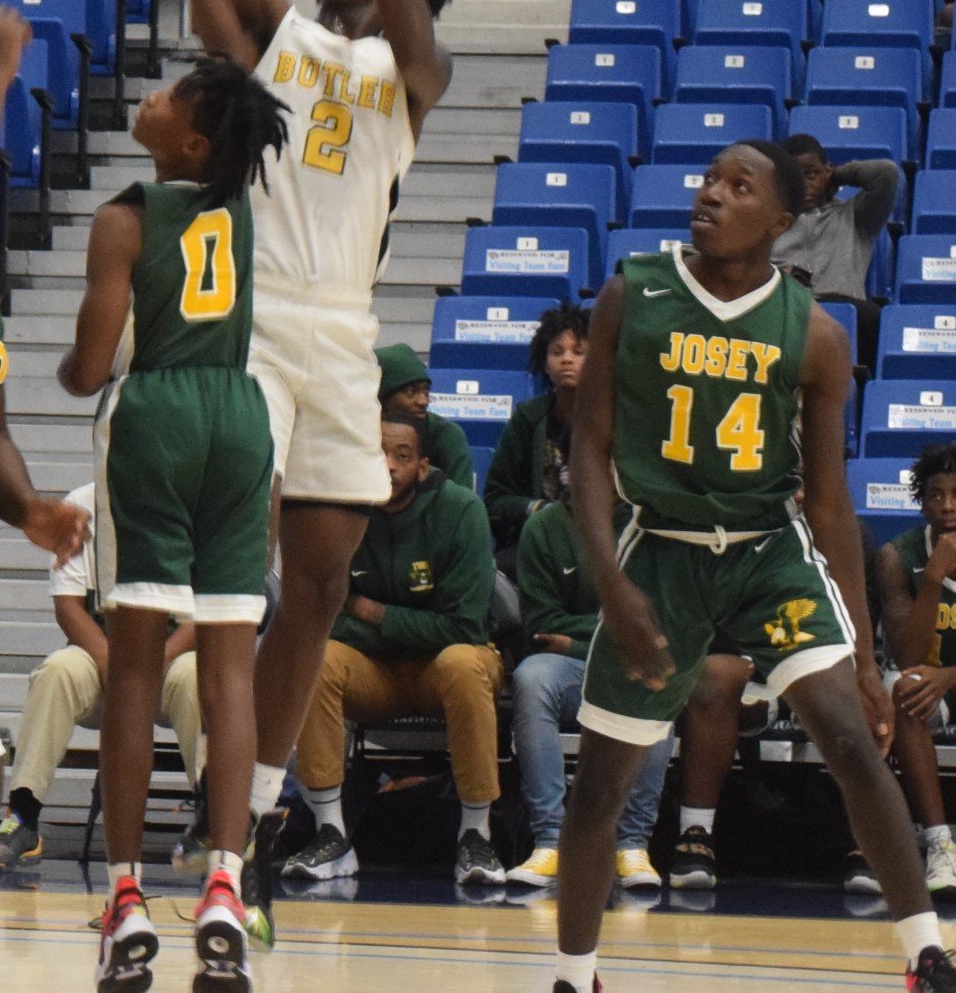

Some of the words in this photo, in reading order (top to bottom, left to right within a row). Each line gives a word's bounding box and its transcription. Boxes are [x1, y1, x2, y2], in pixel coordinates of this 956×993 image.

[273, 50, 396, 118] BUTLER
[302, 98, 354, 176] 2
[179, 207, 237, 323] 0
[660, 332, 782, 384] JOSEY
[661, 384, 765, 471] 14
